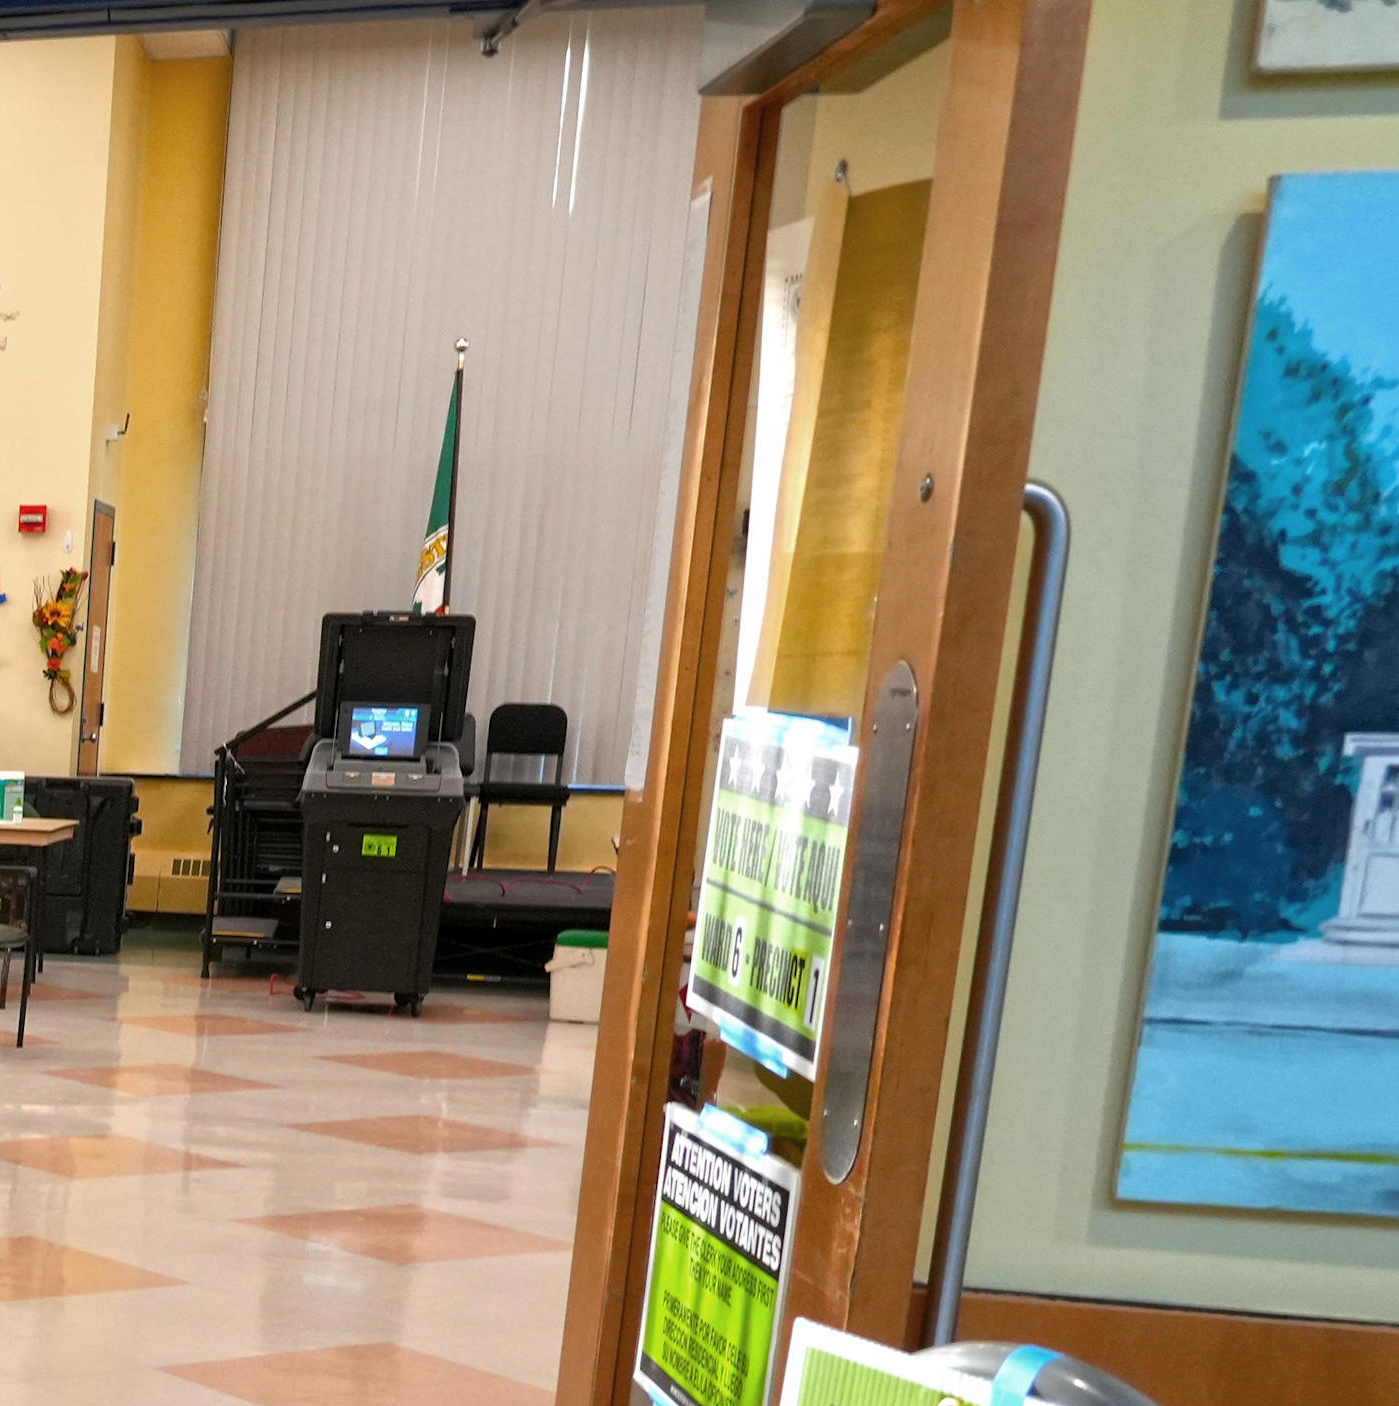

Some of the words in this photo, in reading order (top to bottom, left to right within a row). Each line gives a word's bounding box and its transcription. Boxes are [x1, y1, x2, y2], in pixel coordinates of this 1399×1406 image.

[713, 808, 742, 872] VOTE
[738, 818, 770, 884] HERE
[803, 840, 840, 914] AQUI
[702, 912, 732, 972] WARD
[732, 927, 742, 978] 6
[750, 936, 806, 1010] PRECINCT
[809, 968, 820, 1024] 1
[662, 1166, 718, 1228] ATENCION
[719, 1199, 782, 1271] VOTANTES
[670, 1132, 732, 1197] ATTENTION
[733, 1165, 782, 1228] VOTERS
